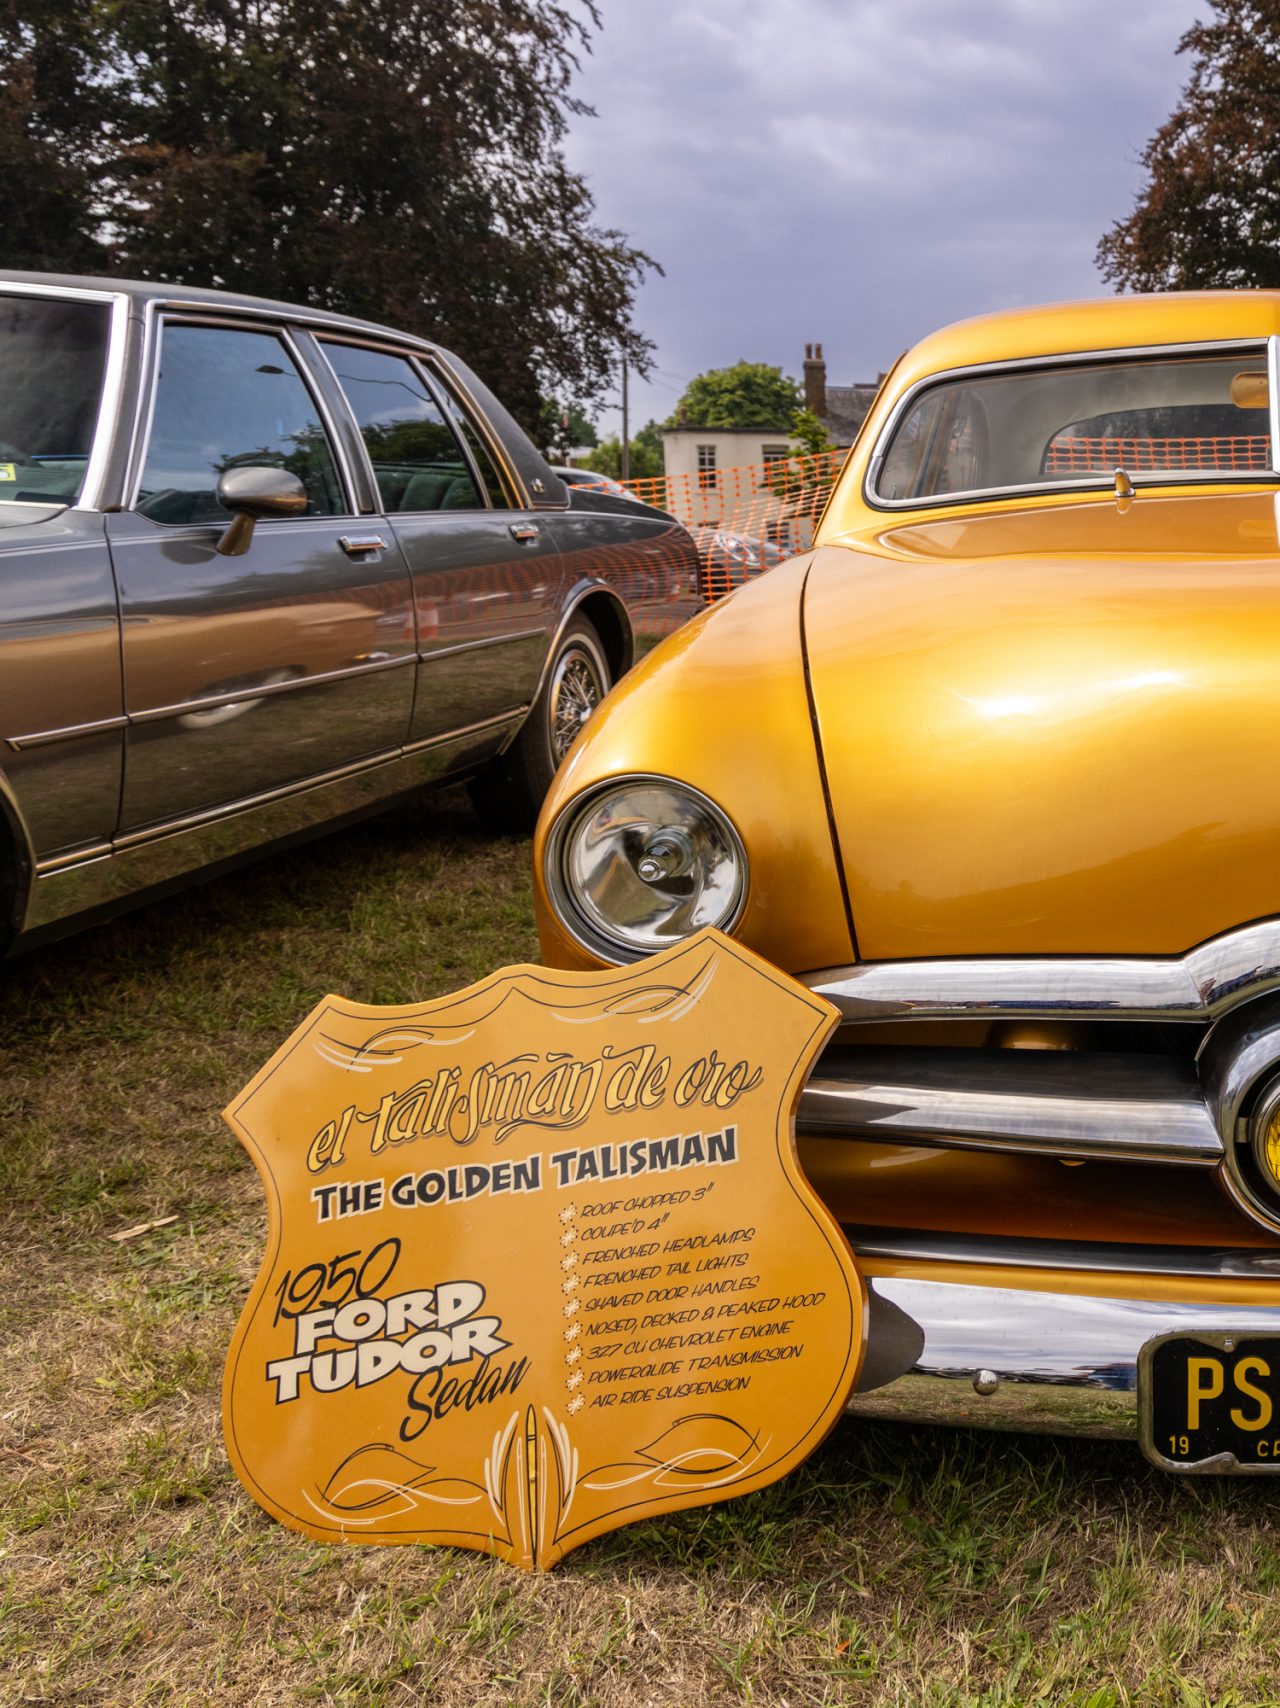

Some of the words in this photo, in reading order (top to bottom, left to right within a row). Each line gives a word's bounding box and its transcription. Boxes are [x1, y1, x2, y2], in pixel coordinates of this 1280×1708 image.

[306, 1104, 356, 1174] el
[602, 1044, 671, 1112] de
[673, 1049, 764, 1109] oro
[312, 1178, 384, 1223] THE
[389, 1154, 545, 1210] GOLDEN
[549, 1124, 740, 1188] TALISMAN
[580, 1200, 625, 1218] ROOF
[624, 1190, 691, 1212] CHOPPED
[580, 1218, 644, 1242] COUPE'D
[582, 1244, 660, 1265] FRENCHED
[662, 1228, 756, 1254] HEADLAMPS
[273, 1237, 401, 1328] 1950
[583, 1266, 662, 1288] FRENCHED
[666, 1261, 690, 1277] TAIL
[695, 1253, 750, 1272] LIGHTS
[584, 1293, 644, 1312] SHAVED
[646, 1286, 689, 1304] DOOR
[691, 1276, 761, 1297] HANDLES
[585, 1318, 638, 1337] NOSED,
[641, 1309, 700, 1330] DECKED
[701, 1307, 715, 1321] &
[717, 1298, 781, 1318] PEAKED
[782, 1292, 827, 1310] HOOD
[294, 1280, 486, 1356] FORD
[266, 1316, 514, 1405] TUDOR
[586, 1343, 623, 1360] 327
[649, 1328, 739, 1352] CHEVROLET
[739, 1320, 795, 1339] ENGINE
[587, 1360, 683, 1385] POWERGLIDE
[687, 1344, 804, 1371] TRANSMISSION
[400, 1356, 532, 1442] Sedan
[588, 1394, 619, 1409] AIR
[619, 1389, 655, 1406] RIDE
[655, 1376, 751, 1401] SUSPENSION
[1187, 1357, 1273, 1432] PS
[1168, 1436, 1189, 1455] 19
